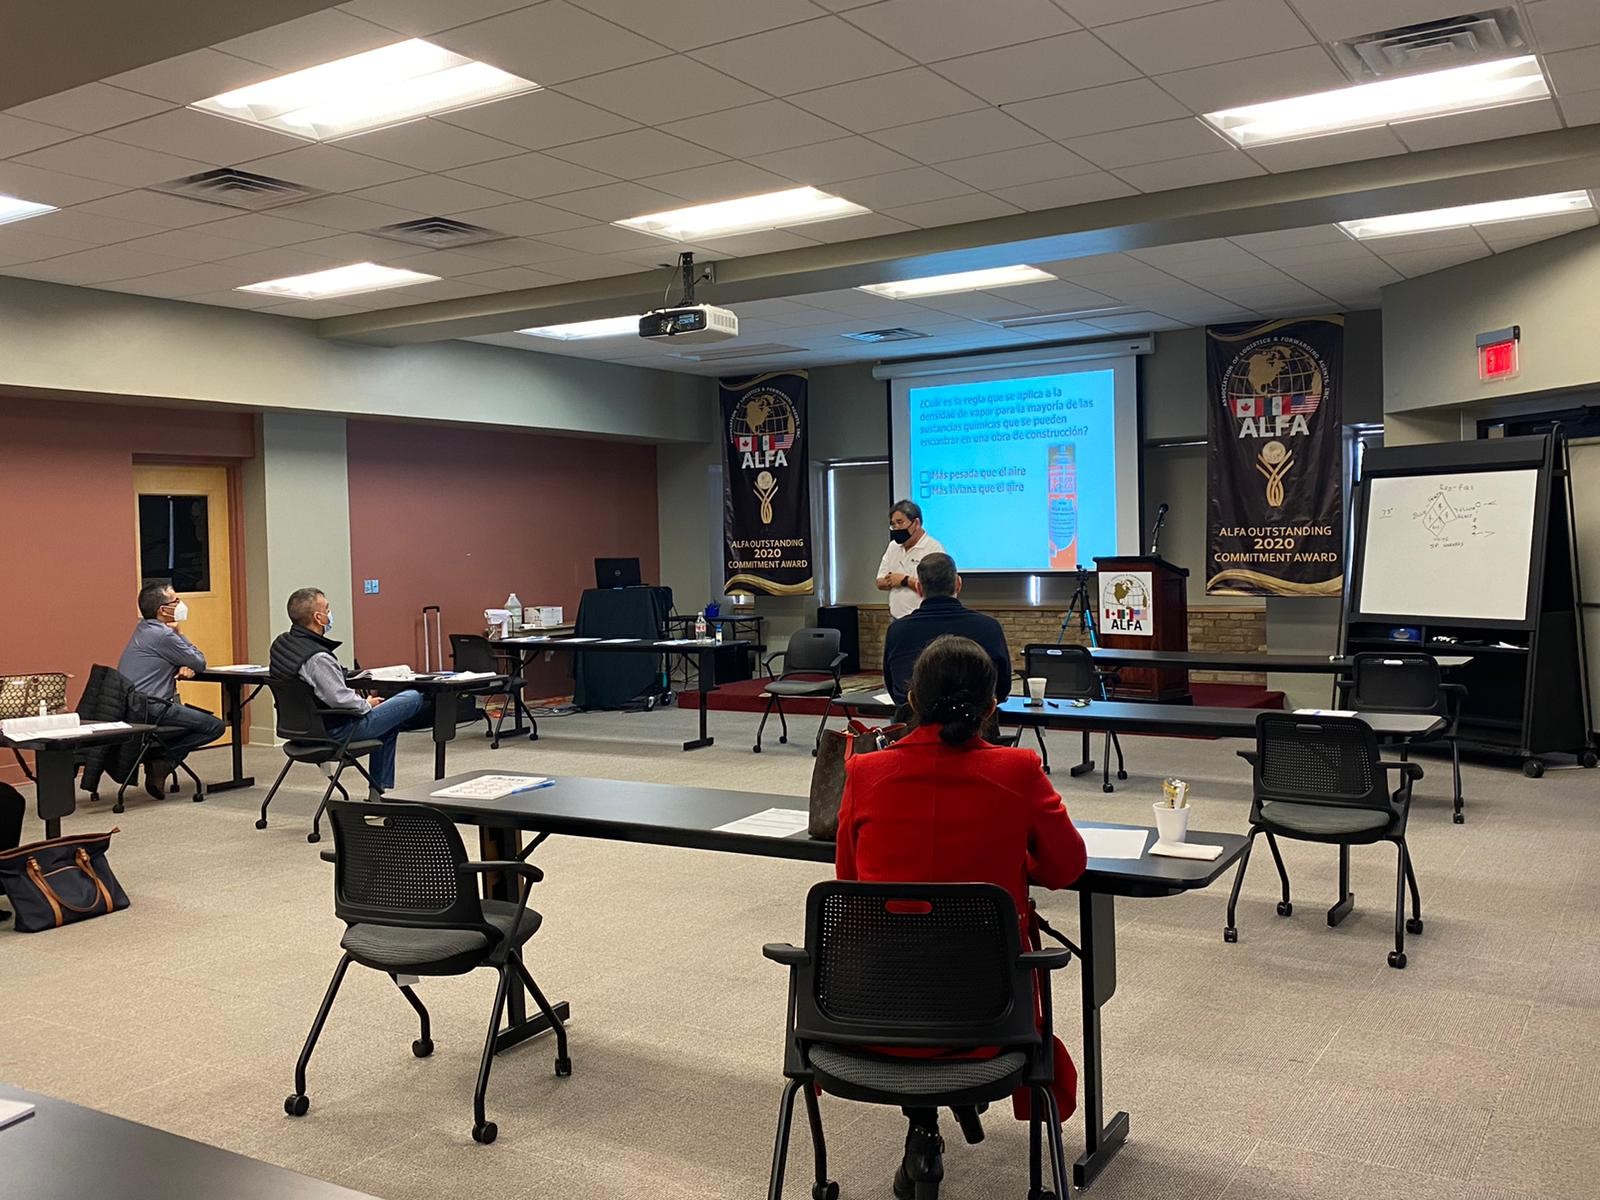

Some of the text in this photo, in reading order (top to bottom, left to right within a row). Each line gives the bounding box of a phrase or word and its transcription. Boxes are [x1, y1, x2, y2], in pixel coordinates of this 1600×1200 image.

[943, 398, 952, 406] es
[964, 394, 985, 406] regla
[988, 393, 1003, 404] que
[1006, 392, 1015, 400] se
[1017, 389, 1043, 402] aplica
[1045, 390, 1051, 398] a
[1053, 387, 1062, 397] la
[920, 397, 1094, 421] densidad de vapor para la mayoría de las
[920, 423, 961, 434] sustancias
[1003, 419, 1019, 429] que
[1021, 418, 1031, 426] se
[1033, 414, 1067, 427] pueden
[1239, 415, 1310, 438] ALFA
[920, 425, 1088, 447] encontrar en una obra de construcción?
[742, 451, 788, 469] ALFA
[949, 467, 978, 481] pesada
[981, 468, 996, 478] que
[1008, 465, 1026, 476] aire
[949, 482, 977, 494] liviana
[979, 482, 995, 495] que
[1006, 481, 1024, 492] aire
[1219, 525, 1332, 536] ALFA OUTSTANDING
[731, 539, 804, 549] ALFA OUTSTANDING
[1254, 538, 1295, 550] 2020
[754, 549, 782, 558] 2020
[1214, 552, 1338, 563] COMMITMENT AWARD
[728, 560, 808, 569] COMMITMENT AWARD
[1111, 619, 1143, 631] ALFA
